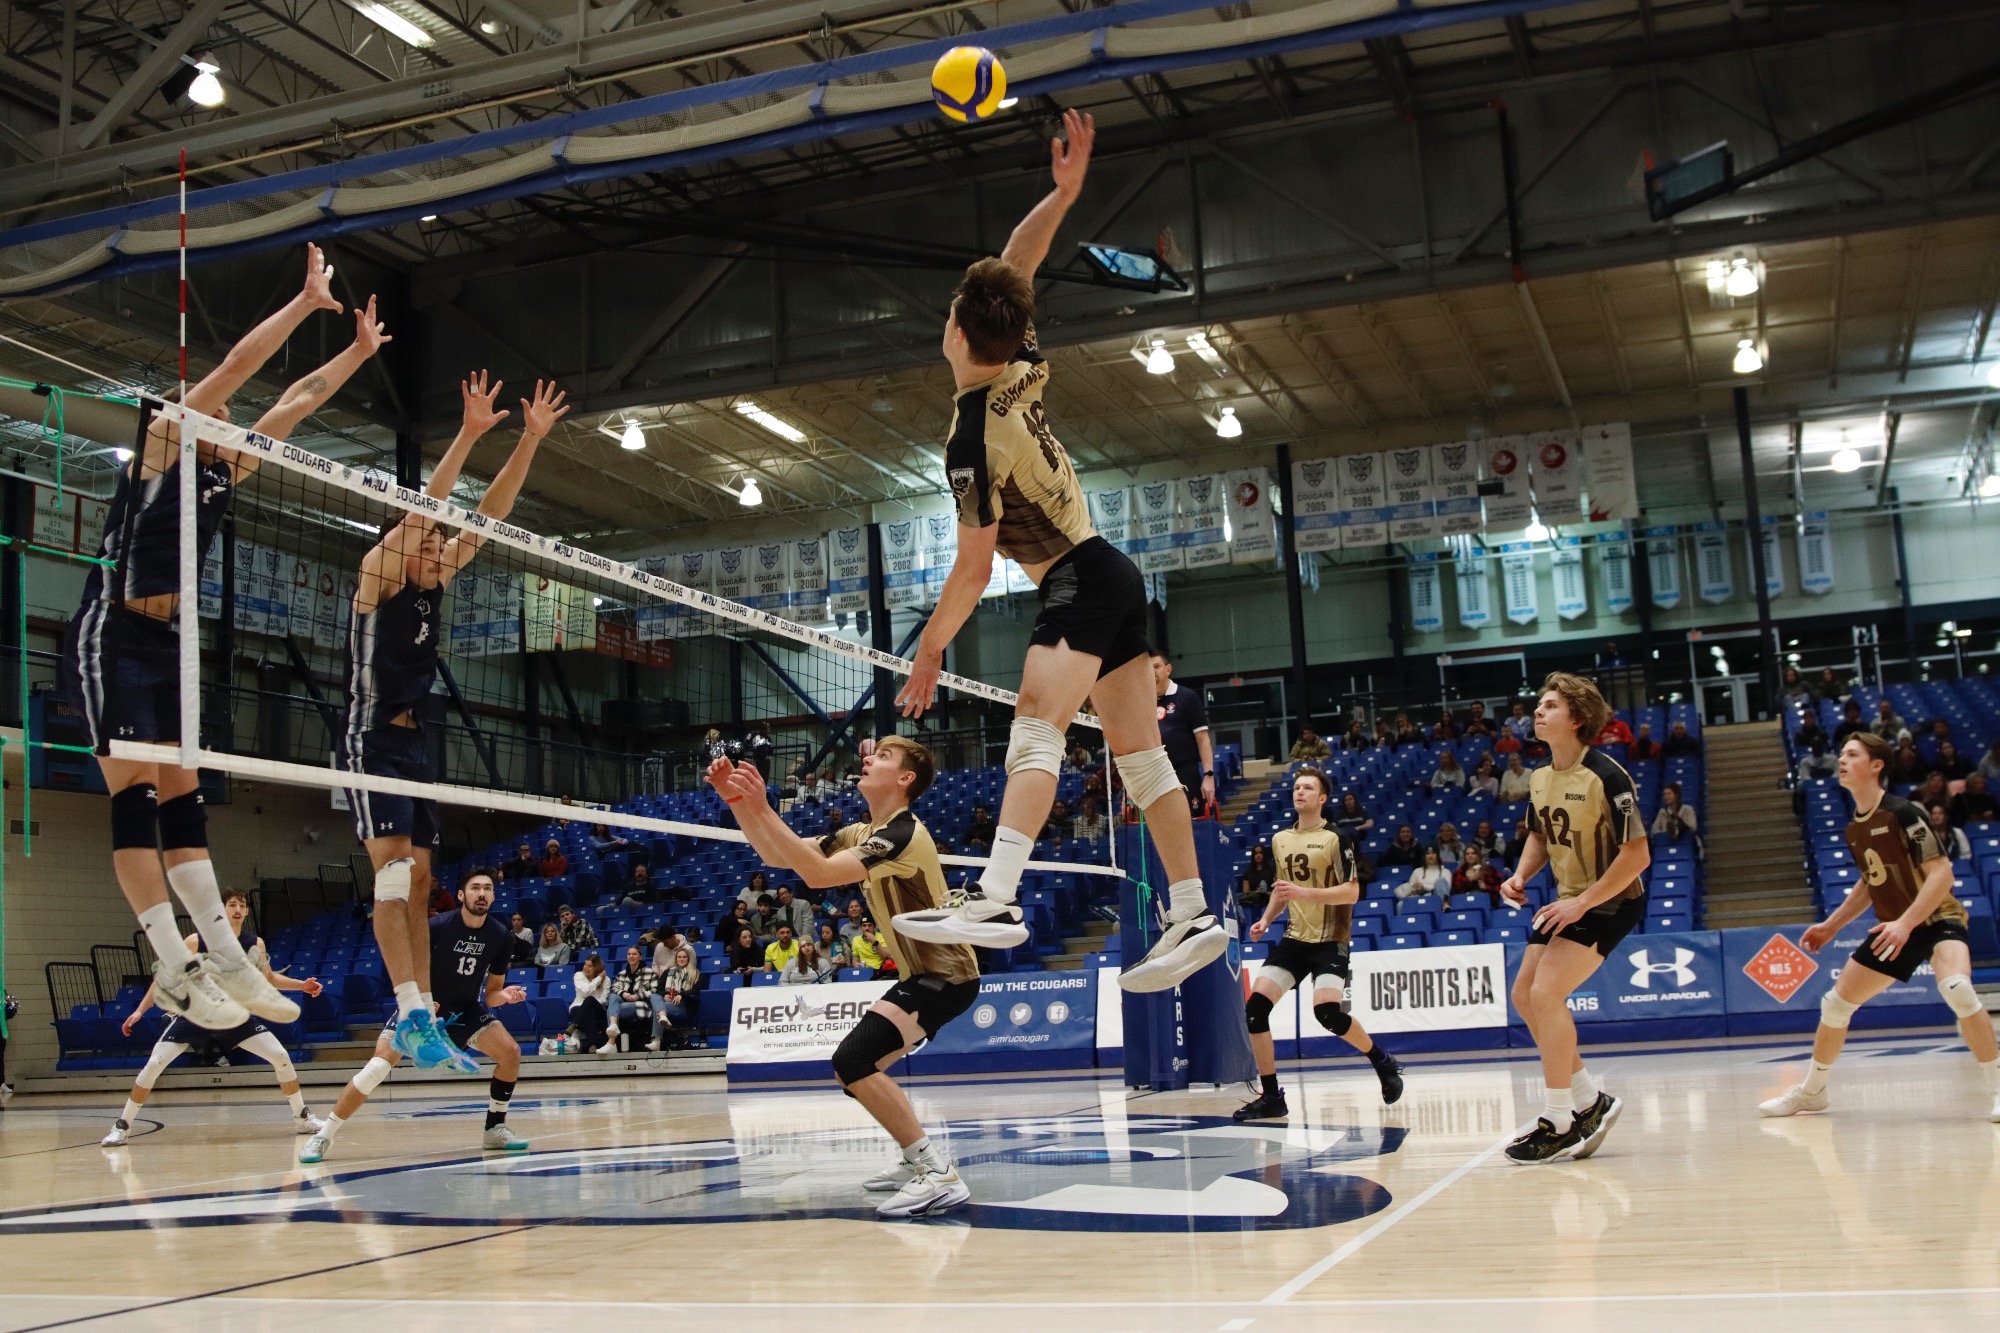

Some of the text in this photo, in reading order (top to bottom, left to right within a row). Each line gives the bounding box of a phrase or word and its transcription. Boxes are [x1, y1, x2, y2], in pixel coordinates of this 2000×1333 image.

[1390, 480, 1428, 490] COUGARS
[1438, 474, 1476, 486] COUGARS
[1297, 491, 1334, 502] COUGARS
[1344, 486, 1380, 496] COUGARS
[1140, 512, 1176, 524] COUGARS
[1186, 507, 1220, 518] COUGARS
[1096, 520, 1130, 530] COUGARS
[1194, 517, 1214, 528] 2004
[1150, 523, 1168, 534] 2004
[1106, 530, 1124, 541] 2004
[245, 431, 274, 451] MRU
[283, 446, 332, 474] COUGARS
[362, 476, 388, 492] MRU
[396, 488, 438, 512] COUGARS
[464, 511, 487, 527] MRU
[494, 522, 531, 544] COUGARS
[580, 552, 611, 572] COUGARS
[654, 578, 683, 598] COUGARS
[720, 601, 747, 616] COUGARS
[780, 620, 804, 636] COUGARS
[834, 640, 854, 653] COUGARS
[884, 550, 918, 560] COUGARS
[924, 545, 958, 554] COUGARS
[834, 556, 866, 566] COUGARS
[934, 554, 951, 566] 2002
[842, 566, 858, 577] 2002
[893, 560, 911, 572] 2002
[754, 572, 785, 582] COUGARS
[794, 570, 824, 579] COUGARS
[716, 577, 746, 586] COUGARS
[800, 578, 818, 590] 2001
[723, 587, 740, 598] 2001
[762, 582, 778, 593] 2001
[454, 604, 483, 613] COUGARS
[1565, 792, 1586, 802] BISONS
[1539, 806, 1572, 849] 12
[1285, 854, 1310, 882] 13
[454, 940, 486, 954] MRU
[456, 956, 477, 976] 13
[979, 978, 1087, 994] LOW THE COUGARS!
[1370, 966, 1494, 1012] USPORTS.CA
[1619, 994, 1658, 1004] UNDER
[737, 1001, 872, 1030] GREY EAG
[760, 1024, 803, 1034] RESORT
[806, 1024, 813, 1032] &
[988, 1034, 1050, 1044] @mrucougars
